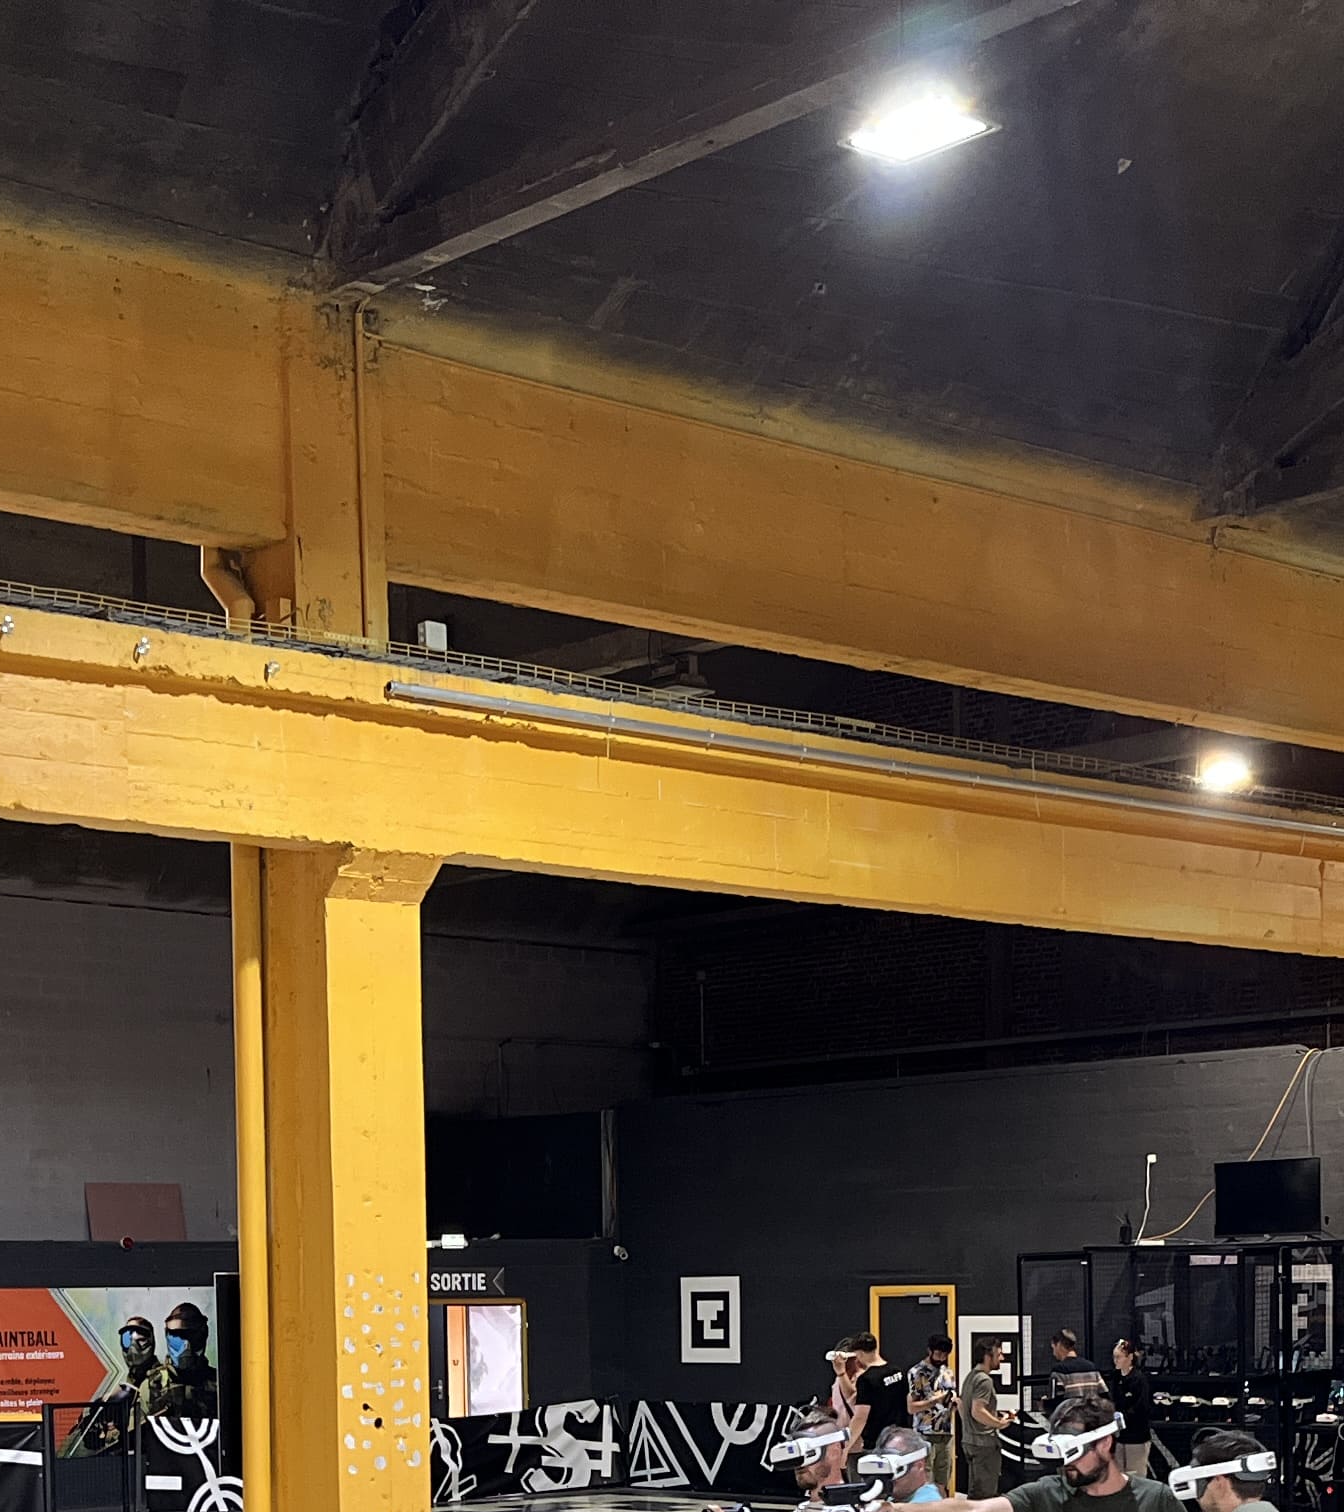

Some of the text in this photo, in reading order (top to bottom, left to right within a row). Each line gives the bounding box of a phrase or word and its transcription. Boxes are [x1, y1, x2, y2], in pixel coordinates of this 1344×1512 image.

[430, 1272, 487, 1291] SORTIE
[25, 1349, 65, 1360] extérieurs
[883, 1371, 903, 1387] STAFF
